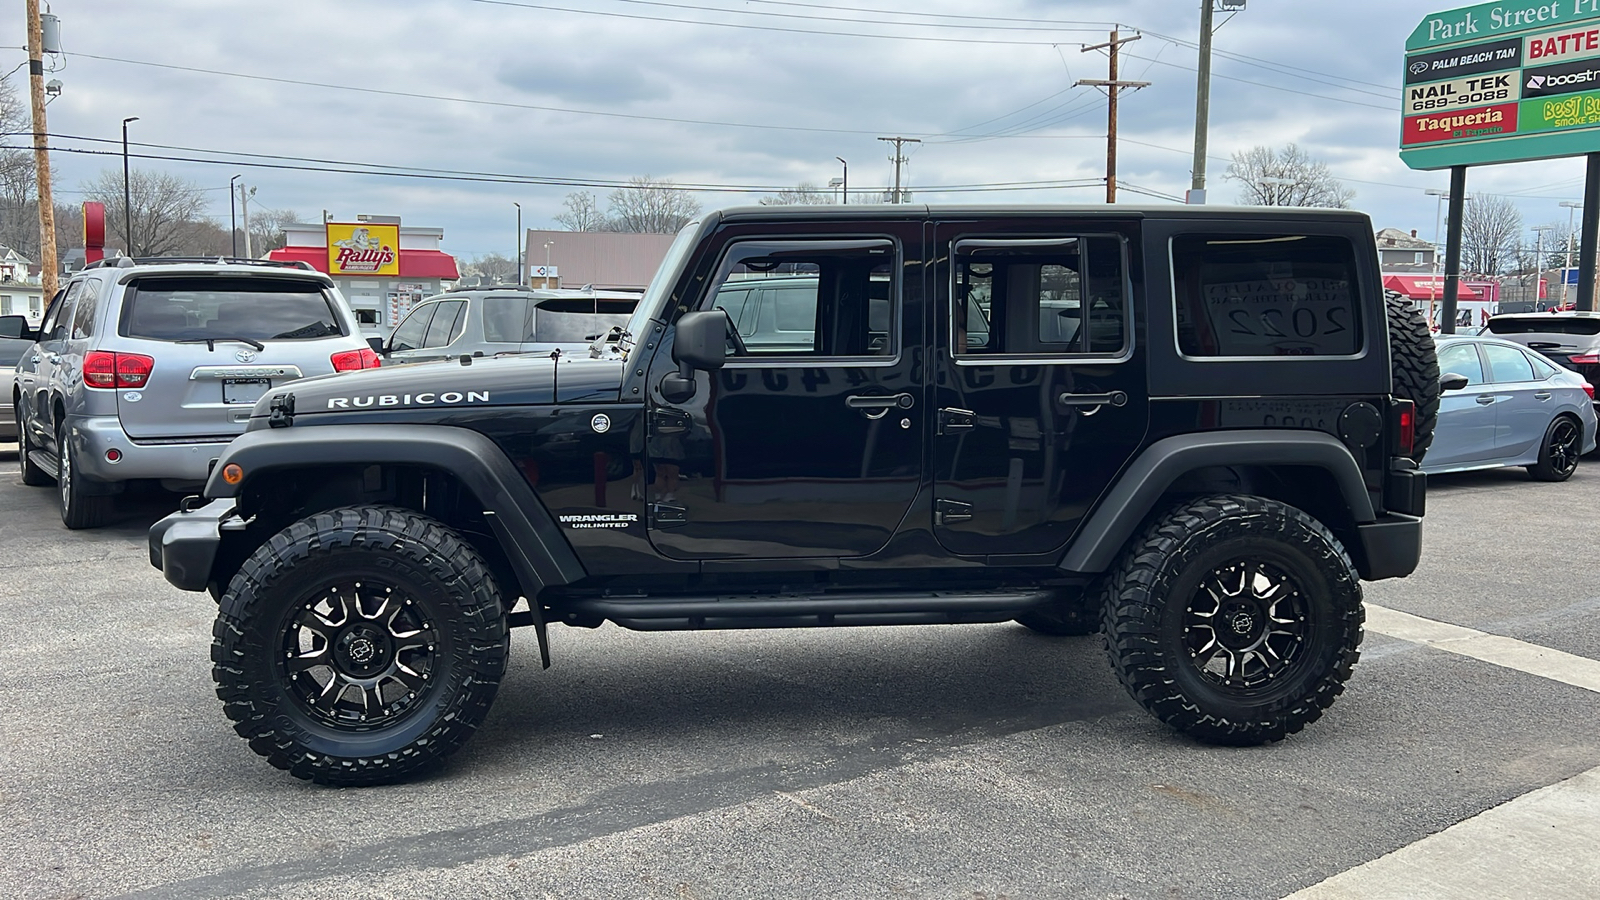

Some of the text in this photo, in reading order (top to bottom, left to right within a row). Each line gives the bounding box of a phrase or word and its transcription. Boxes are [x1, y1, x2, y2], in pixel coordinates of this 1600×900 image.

[1428, 12, 1479, 41] Park
[1490, 1, 1560, 30] Street
[1530, 29, 1600, 59] BATTE
[1432, 48, 1516, 71] PALM BEACH TAN
[1411, 75, 1510, 100] NAIL TEK
[1412, 89, 1508, 111] 689-9088
[1554, 116, 1587, 127] SMOKE
[1453, 130, 1462, 138] El
[335, 245, 394, 270] Rally's
[214, 369, 279, 377] SEQUOIA
[327, 390, 490, 409] RUBICON
[559, 514, 638, 523] WRANGLER
